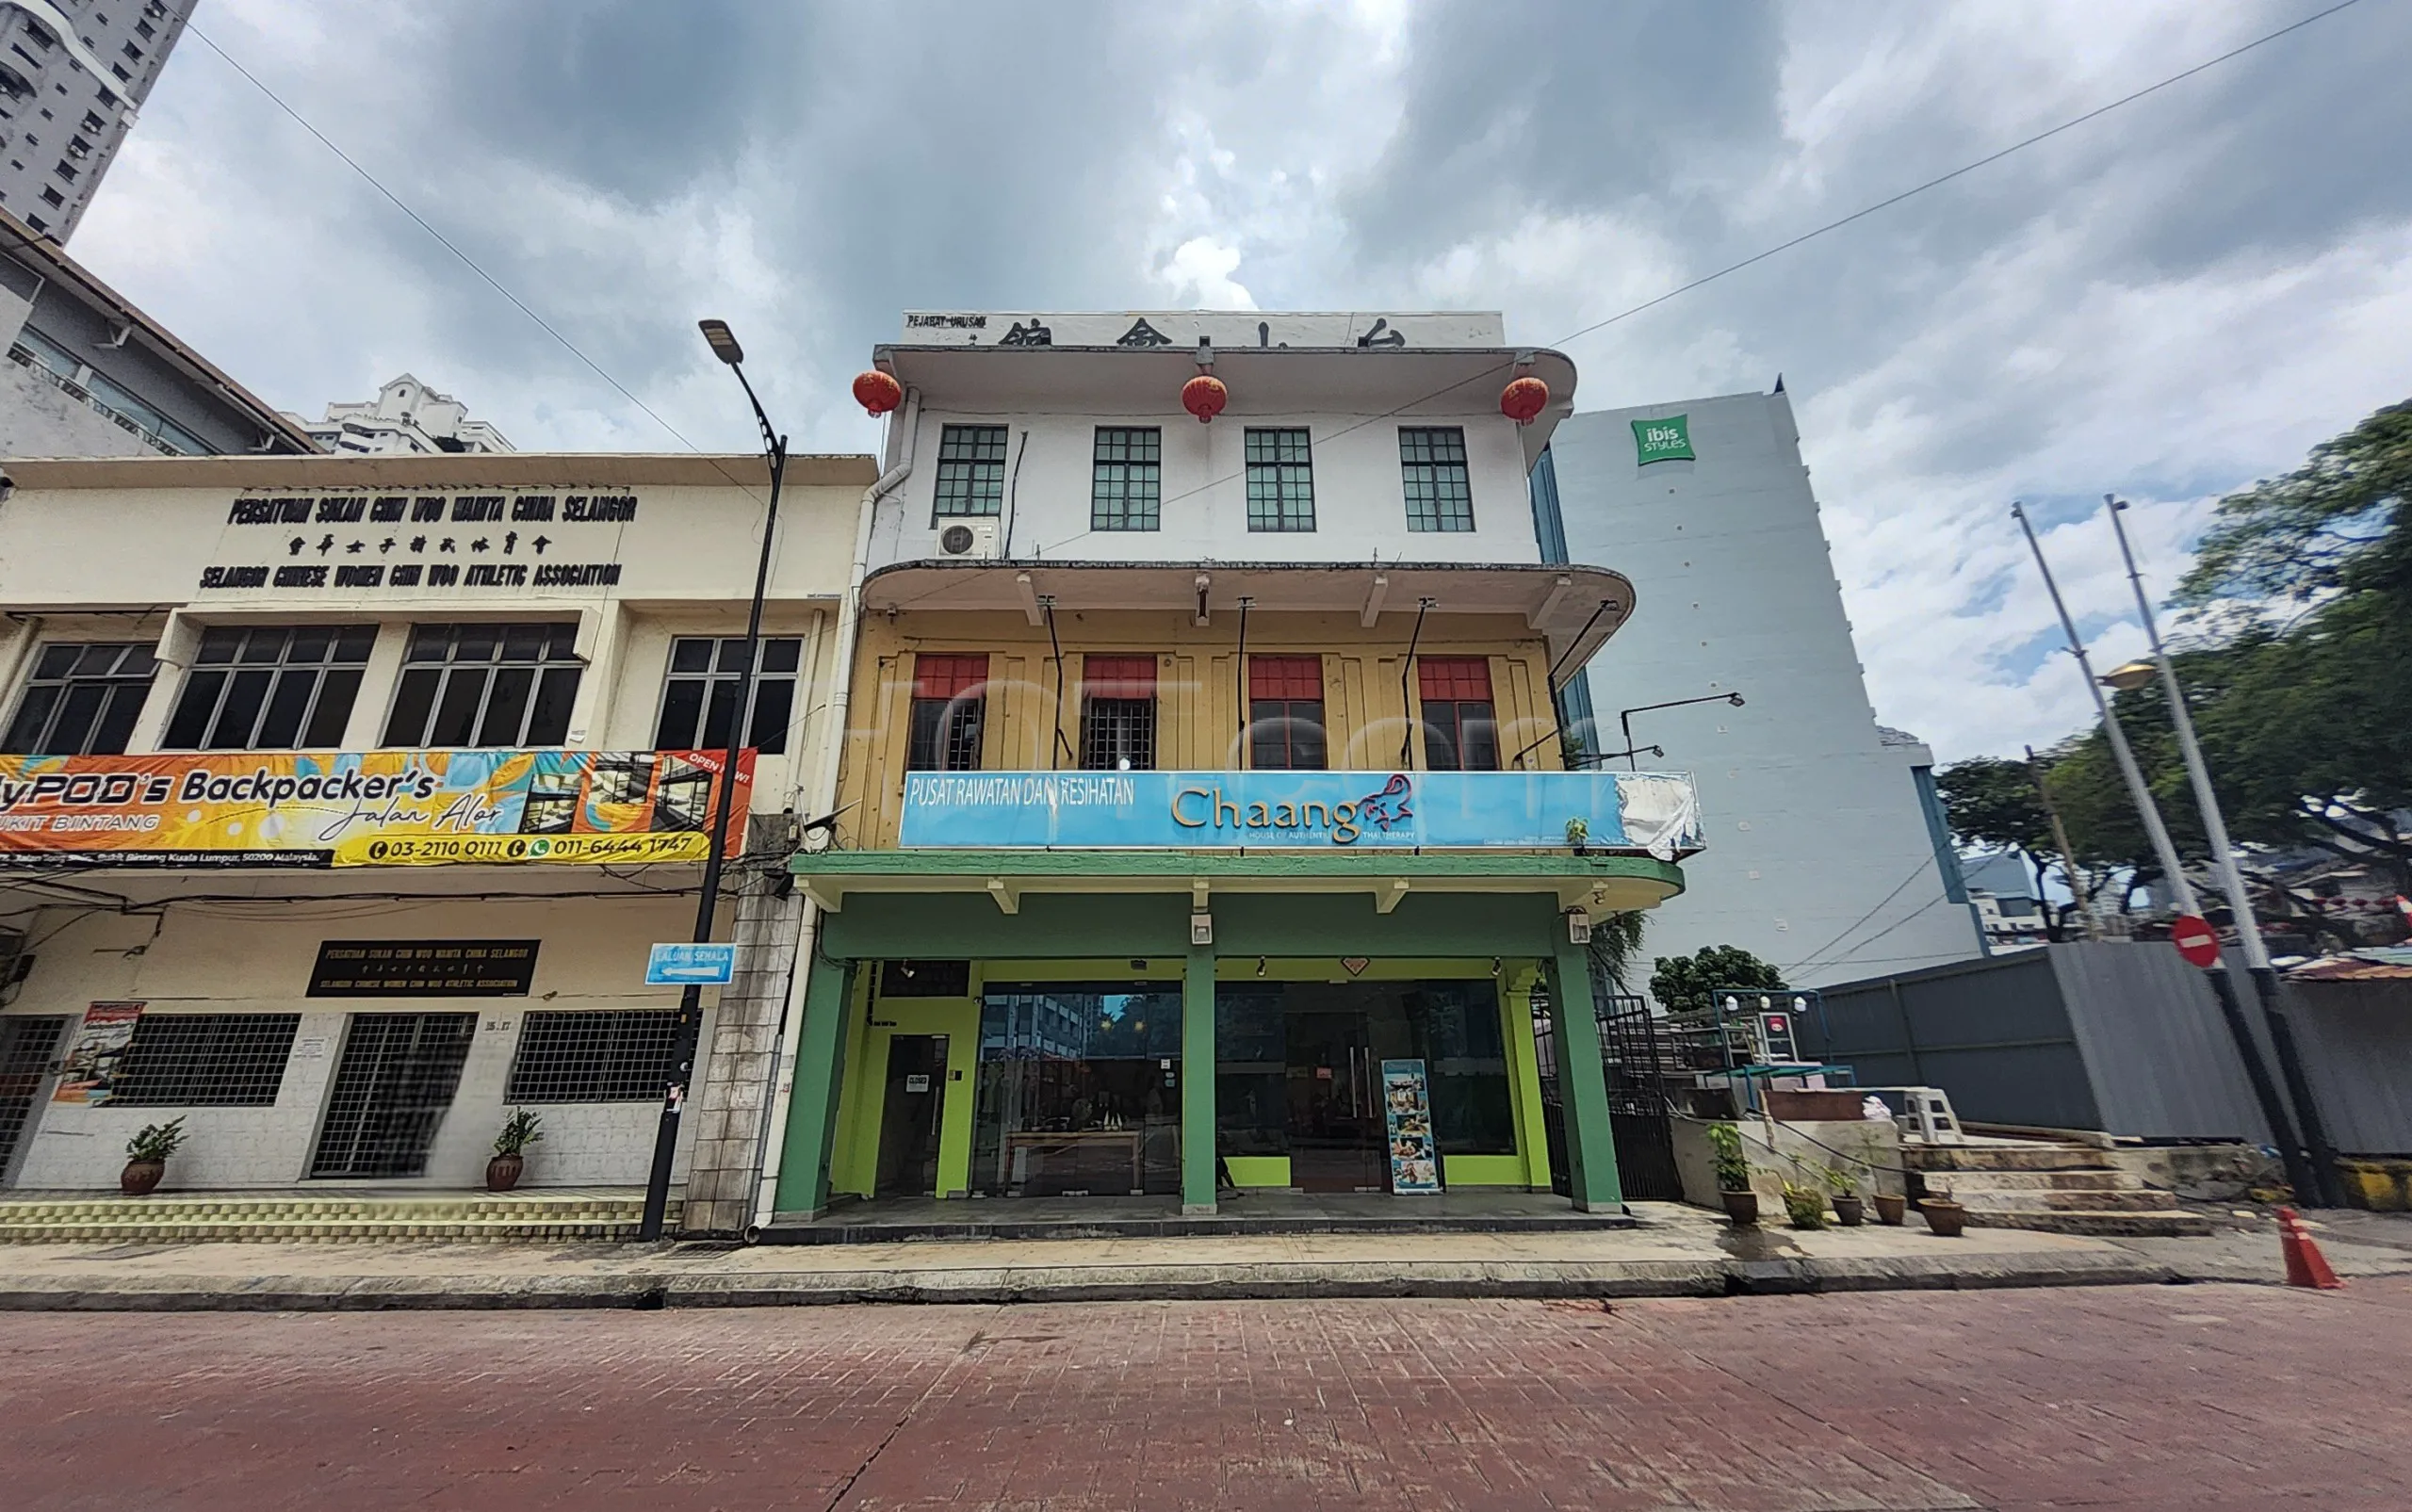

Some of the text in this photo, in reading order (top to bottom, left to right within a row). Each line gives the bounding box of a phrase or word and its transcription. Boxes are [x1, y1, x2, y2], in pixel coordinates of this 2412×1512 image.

[1646, 427, 1679, 442] ibis
[227, 495, 638, 525] PERSATUAN SUKAN CHIN WOO WANITA CHINA SELANGOR
[200, 563, 623, 588] SELANGOR CHINESE WOMEN CHIN WOO ATHLETIC ASSOCIATION
[689, 753, 721, 772] OPEN
[182, 769, 435, 807] Backpacker's
[909, 777, 954, 806] PUSAT
[955, 776, 1022, 806] RAWATAN
[53, 815, 161, 831] BINTANG
[319, 793, 502, 840] Jalan Alor
[1171, 788, 1361, 843] Chaang
[1362, 831, 1382, 839] THAI
[1384, 831, 1415, 839] THERAPY
[390, 840, 502, 856] 03-2110 0111
[554, 837, 693, 854] 011-6444 1747
[125, 853, 167, 864] Bintang
[168, 853, 198, 862] Kuala
[242, 852, 274, 862] 50200
[694, 950, 729, 962] SEHALA
